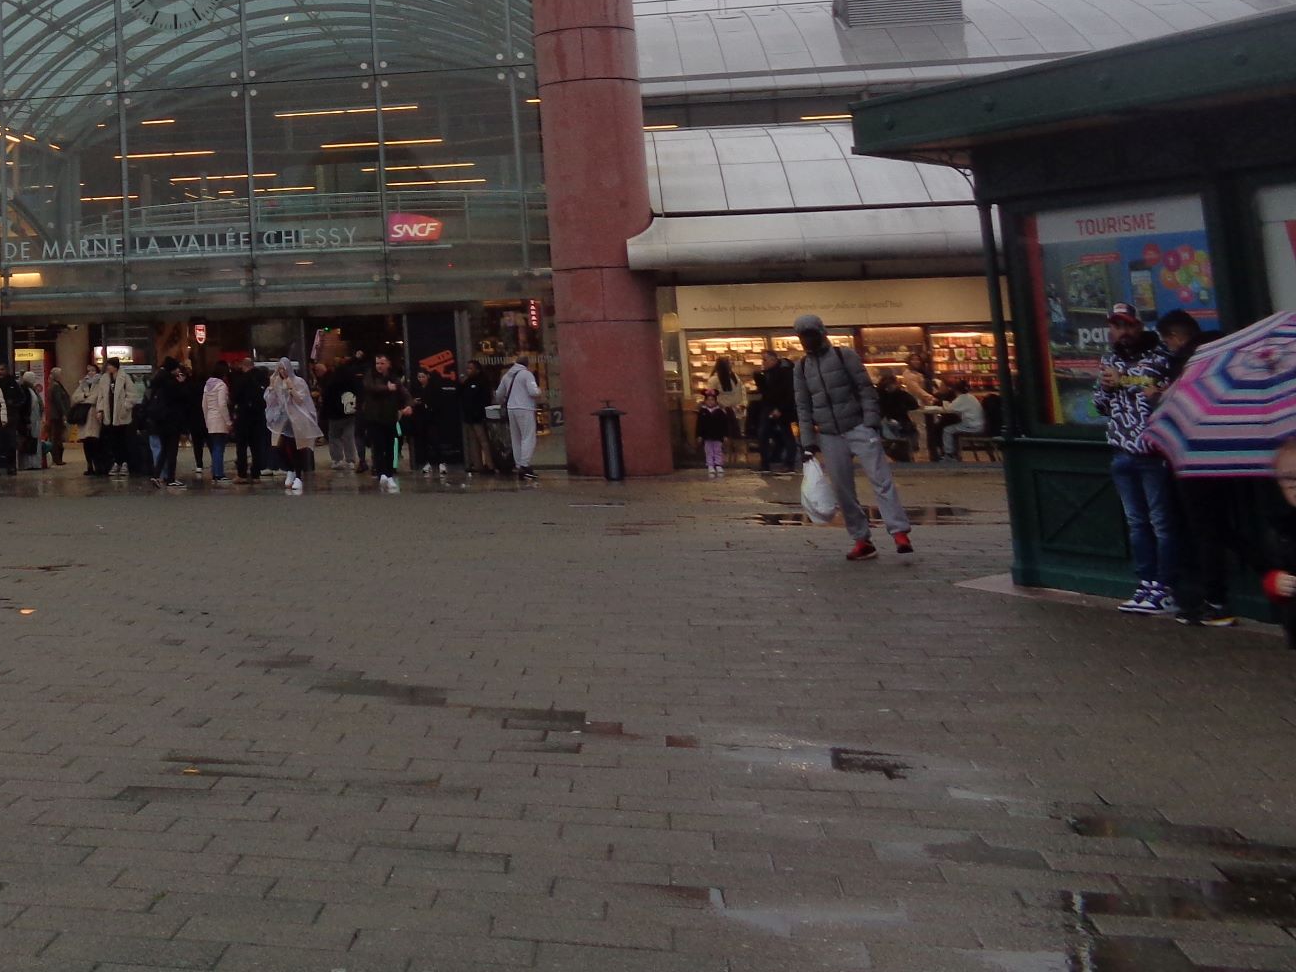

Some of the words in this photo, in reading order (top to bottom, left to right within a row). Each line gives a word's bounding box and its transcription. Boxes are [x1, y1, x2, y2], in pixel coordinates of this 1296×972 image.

[391, 222, 438, 238] SNCF
[1075, 212, 1155, 236] TOURISME
[4, 241, 32, 260] DE
[42, 237, 124, 259] MARNE
[135, 236, 161, 254] LA
[172, 228, 251, 252] VALLÉE
[263, 227, 357, 247] CHESSY
[529, 299, 538, 326] TABAC
